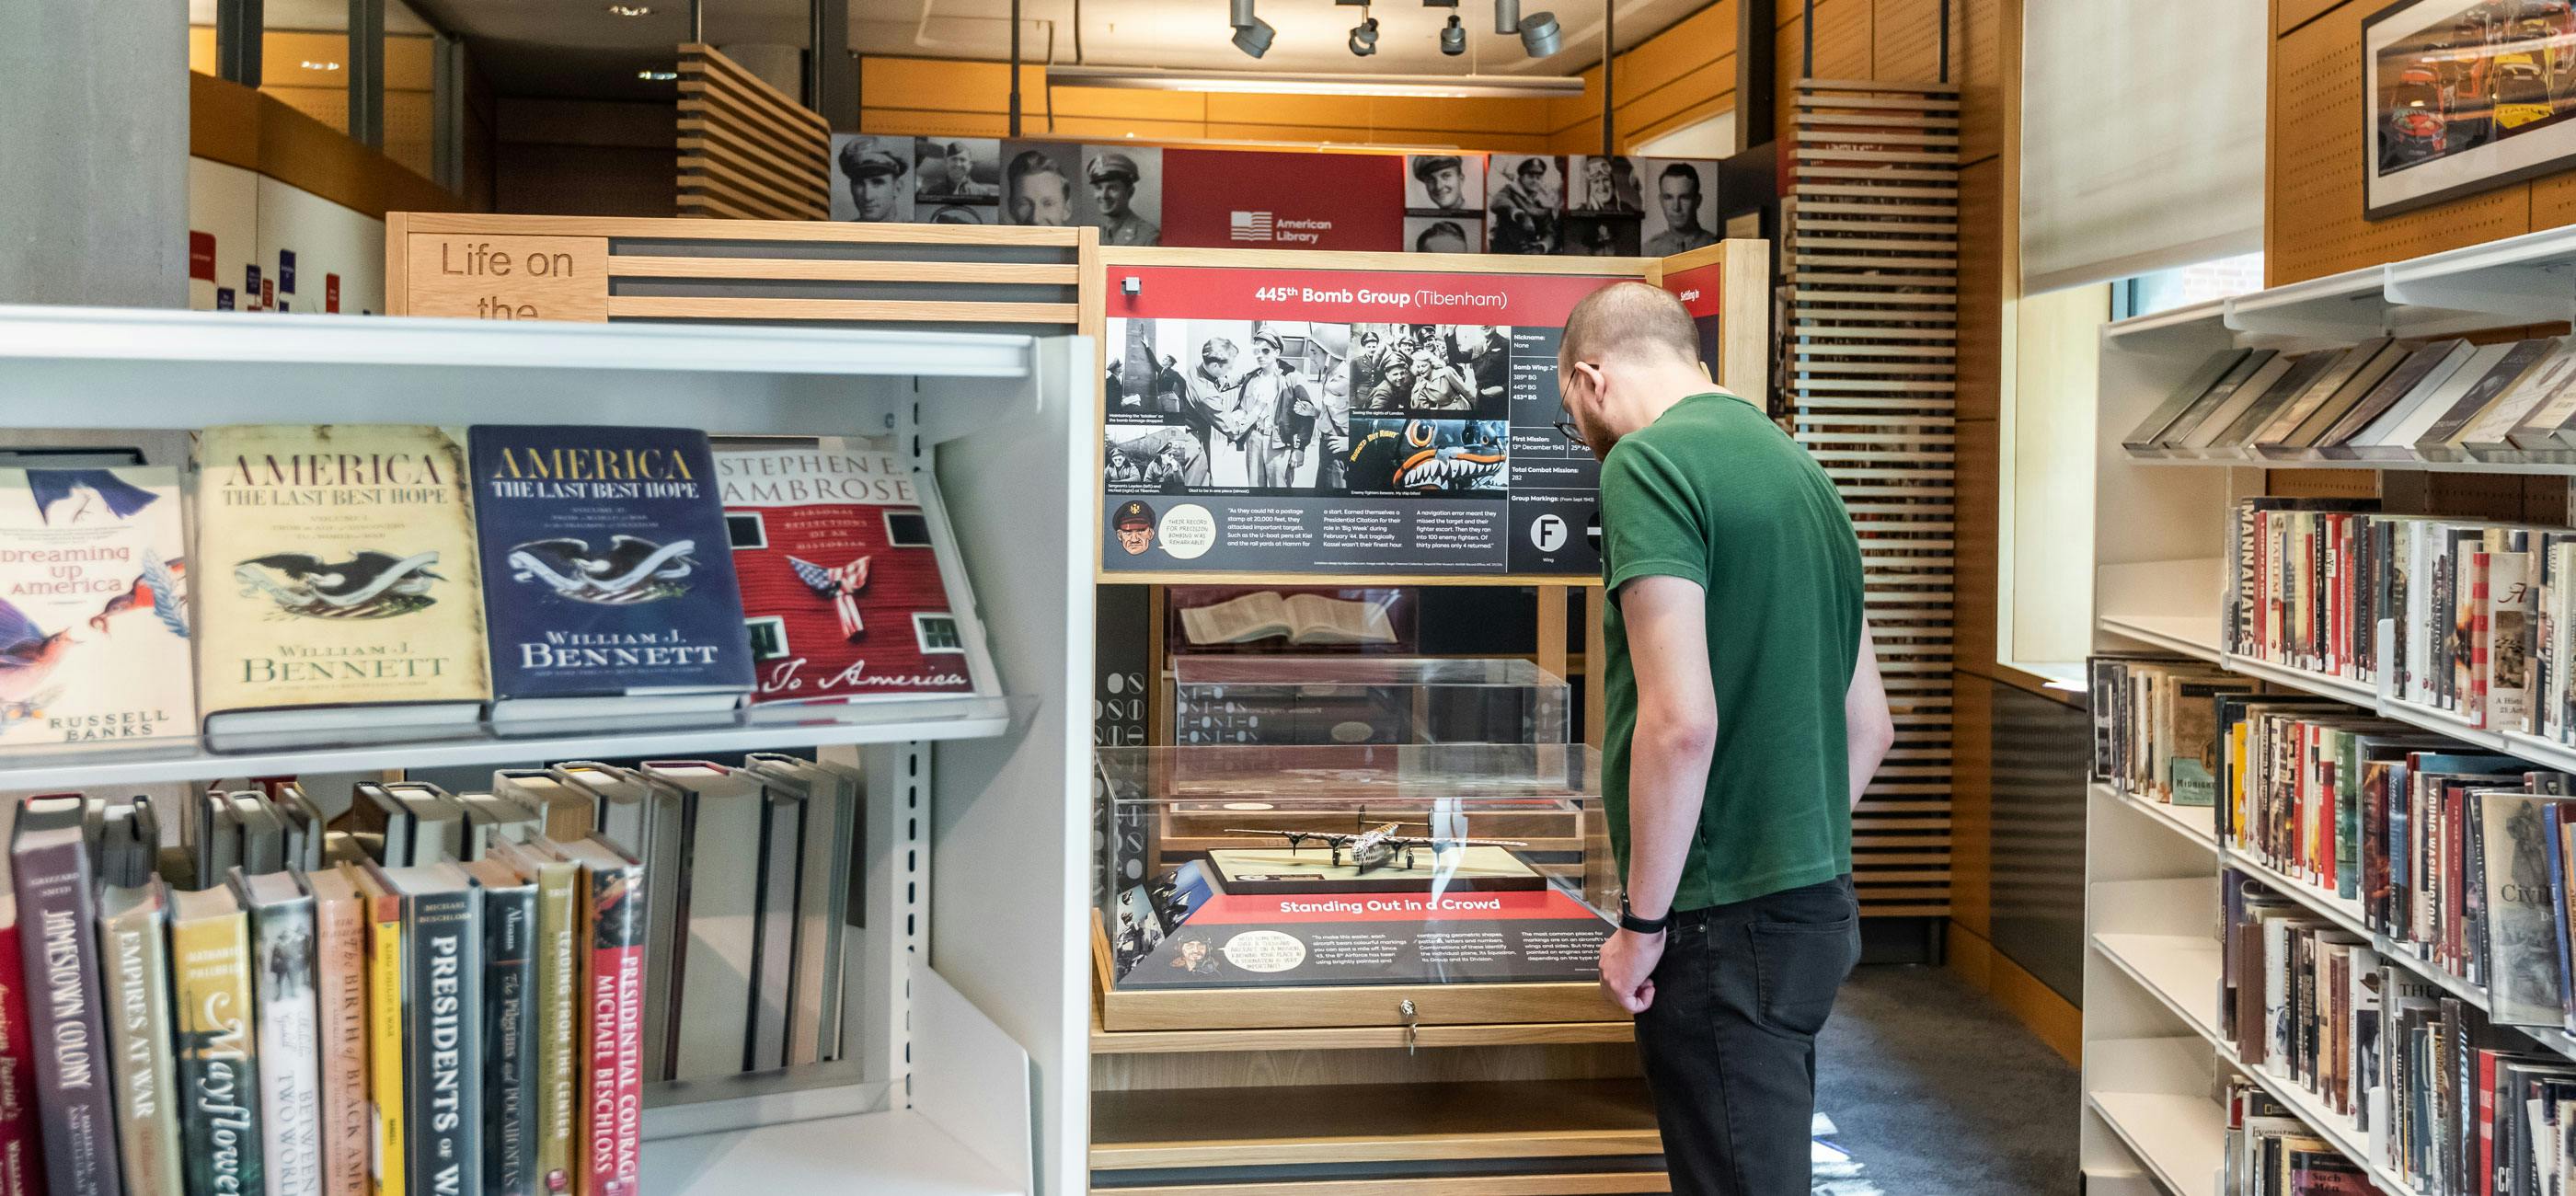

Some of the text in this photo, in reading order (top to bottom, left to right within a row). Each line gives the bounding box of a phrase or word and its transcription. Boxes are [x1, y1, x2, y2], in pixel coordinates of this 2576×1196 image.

[1277, 219, 1332, 230] American
[1277, 231, 1319, 244] Library
[442, 242, 573, 276] Life on
[477, 296, 538, 320] the
[1255, 287, 1508, 309] 445th Bomb Group (Tibenham)
[224, 453, 443, 486] AMERICA
[493, 447, 693, 480] AMERICA
[720, 456, 904, 475] STEPHEN E.
[223, 488, 448, 506] THE LAST BEST HOPE
[491, 481, 700, 499] THE LAST BEST HOPE
[723, 478, 914, 501] AMBROSE
[1541, 520, 1559, 546] F
[11, 578, 122, 595] America
[51, 565, 83, 580] up
[2434, 570, 2443, 654] REVOLUTION
[393, 642, 414, 654] J.
[663, 629, 687, 643] J.
[763, 658, 968, 693] To America
[49, 710, 169, 729] RUSSELL
[66, 724, 153, 742] BANKS
[2428, 788, 2438, 926] YOUNG WASHINGTON
[1280, 900, 1363, 914] Standing
[1367, 900, 1398, 911] Out
[1404, 899, 1421, 910] in
[1442, 899, 1501, 910] Crowd
[506, 906, 523, 951] Abrams
[41, 909, 86, 1019] JAMESTOWN
[119, 930, 149, 1029] EMPIRES
[503, 972, 519, 996] The
[344, 974, 361, 1042] BIRTH
[500, 999, 522, 1058] Pilgrims
[556, 931, 573, 1140] LEADING FROM THE CENTER
[54, 1020, 92, 1090] COLONY
[129, 1037, 150, 1063] AT
[430, 935, 460, 1196] PRESIDENTS OF W
[594, 975, 617, 1174] MICHAEL BESCHLOSS
[617, 956, 640, 1185] PRESIDENTIAL COURAGE
[132, 1067, 155, 1120] WAR
[198, 991, 251, 1196] Mayflowe
[346, 1069, 362, 1138] BLACK
[278, 1075, 297, 1196] TWO WORL
[299, 1090, 316, 1194] BETWEEN
[502, 1087, 522, 1188] POCAHONTAS
